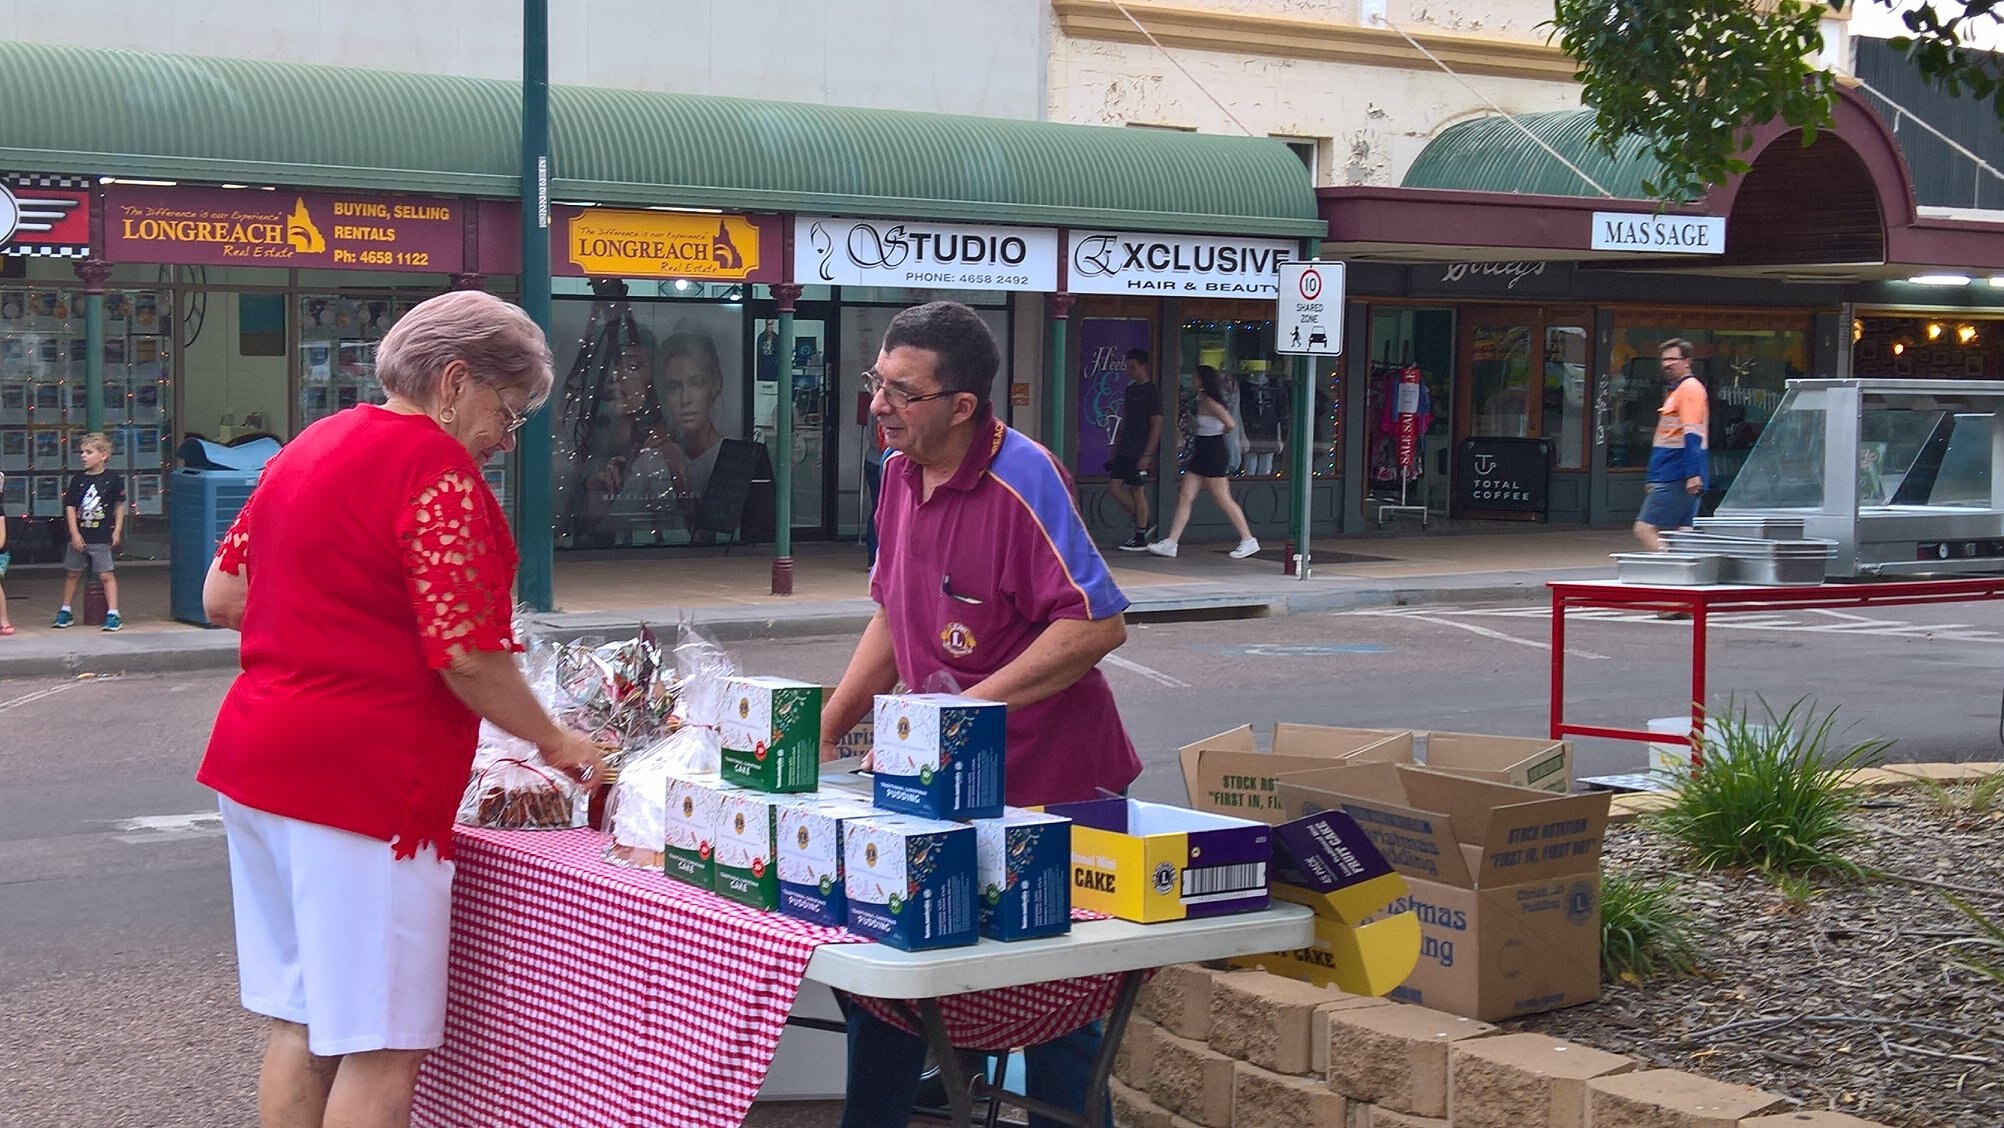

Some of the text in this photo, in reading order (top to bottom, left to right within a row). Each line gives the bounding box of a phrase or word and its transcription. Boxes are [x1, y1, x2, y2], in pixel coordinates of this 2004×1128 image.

[146, 206, 197, 218] Difference
[200, 210, 208, 218] is
[334, 202, 450, 220] BUYING, SELLING
[122, 219, 284, 244] LONGREACH
[334, 225, 396, 242] RENTALS
[223, 244, 294, 259] Real Estate
[578, 238, 709, 261] LONGREACH
[847, 223, 1027, 268] STUDIO
[333, 249, 429, 266] Ph: 4658 1122
[660, 261, 718, 273] Real Estate
[906, 272, 1029, 285] PHONE: 4658 2492
[1127, 279, 1280, 293] HAIR & BEAUTY
[1305, 278, 1317, 292] 10
[1296, 303, 1324, 312] SHARED
[1300, 314, 1319, 323] ZONE
[1473, 480, 1520, 489] TOTAL
[1473, 490, 1530, 501] COFFEE
[1222, 775, 1257, 790] STOCK
[886, 788, 921, 804] PUDDING
[1075, 867, 1116, 893] CAKE
[857, 914, 892, 933] PUDDING
